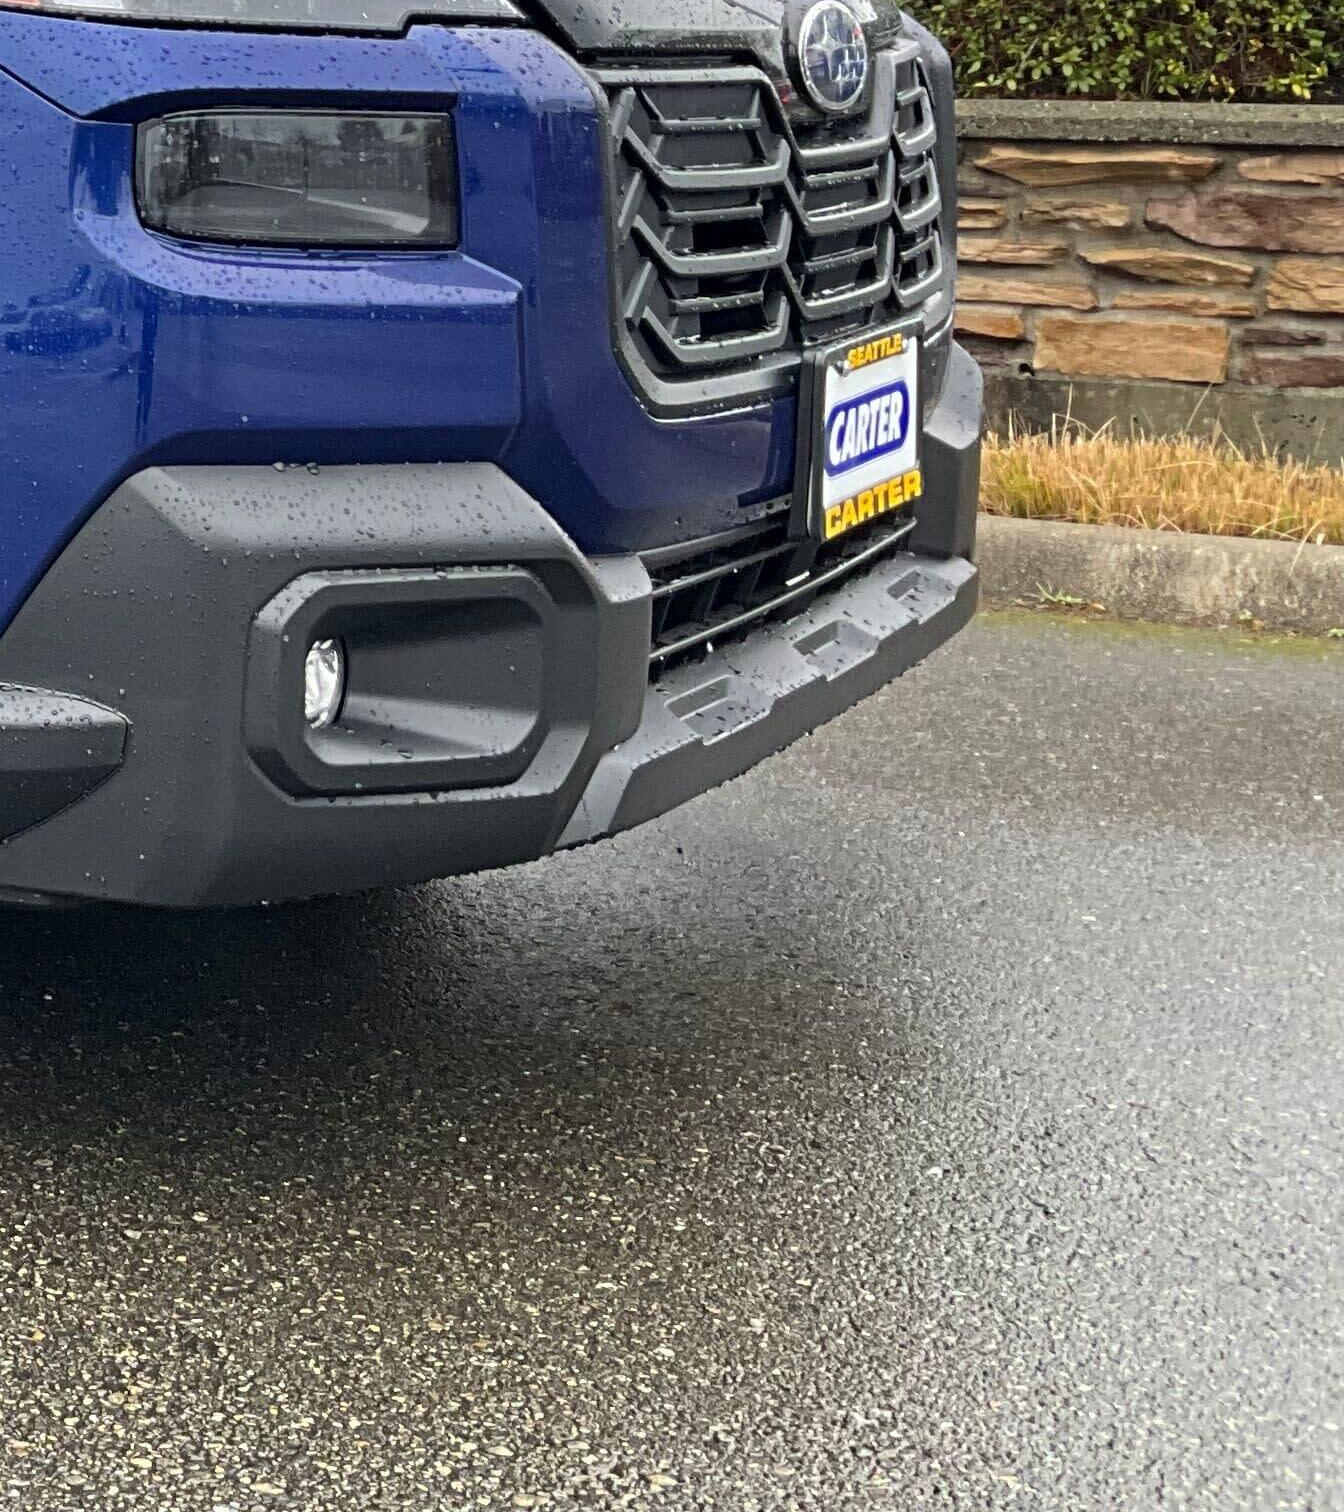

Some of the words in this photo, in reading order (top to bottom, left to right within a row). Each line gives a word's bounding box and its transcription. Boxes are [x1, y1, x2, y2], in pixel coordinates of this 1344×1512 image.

[848, 333, 902, 370] SEATTLE
[828, 390, 904, 466] CARTER
[825, 469, 922, 540] CARTER
